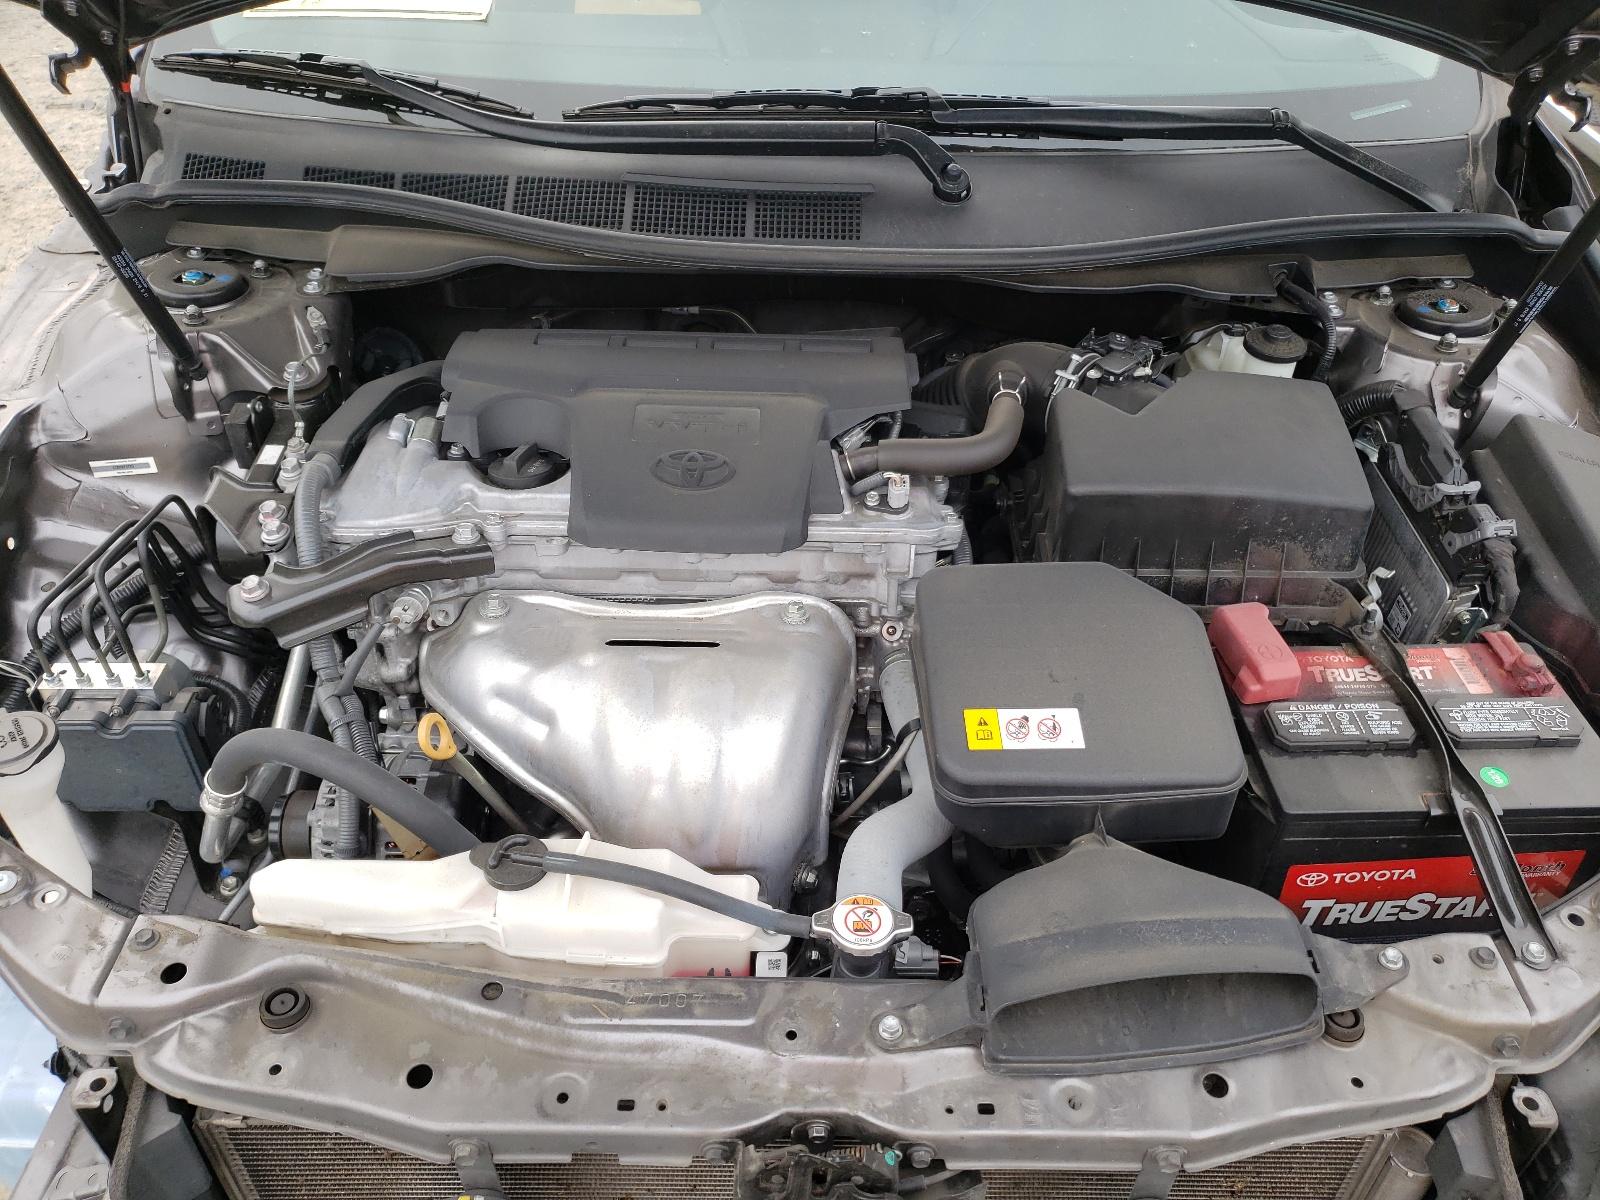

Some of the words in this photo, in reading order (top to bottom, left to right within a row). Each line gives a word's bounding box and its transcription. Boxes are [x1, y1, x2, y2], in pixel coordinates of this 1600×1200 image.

[1308, 655, 1354, 663] TOYOTA
[1298, 703, 1336, 711] DANGER
[1333, 868, 1417, 884] TOYOTA
